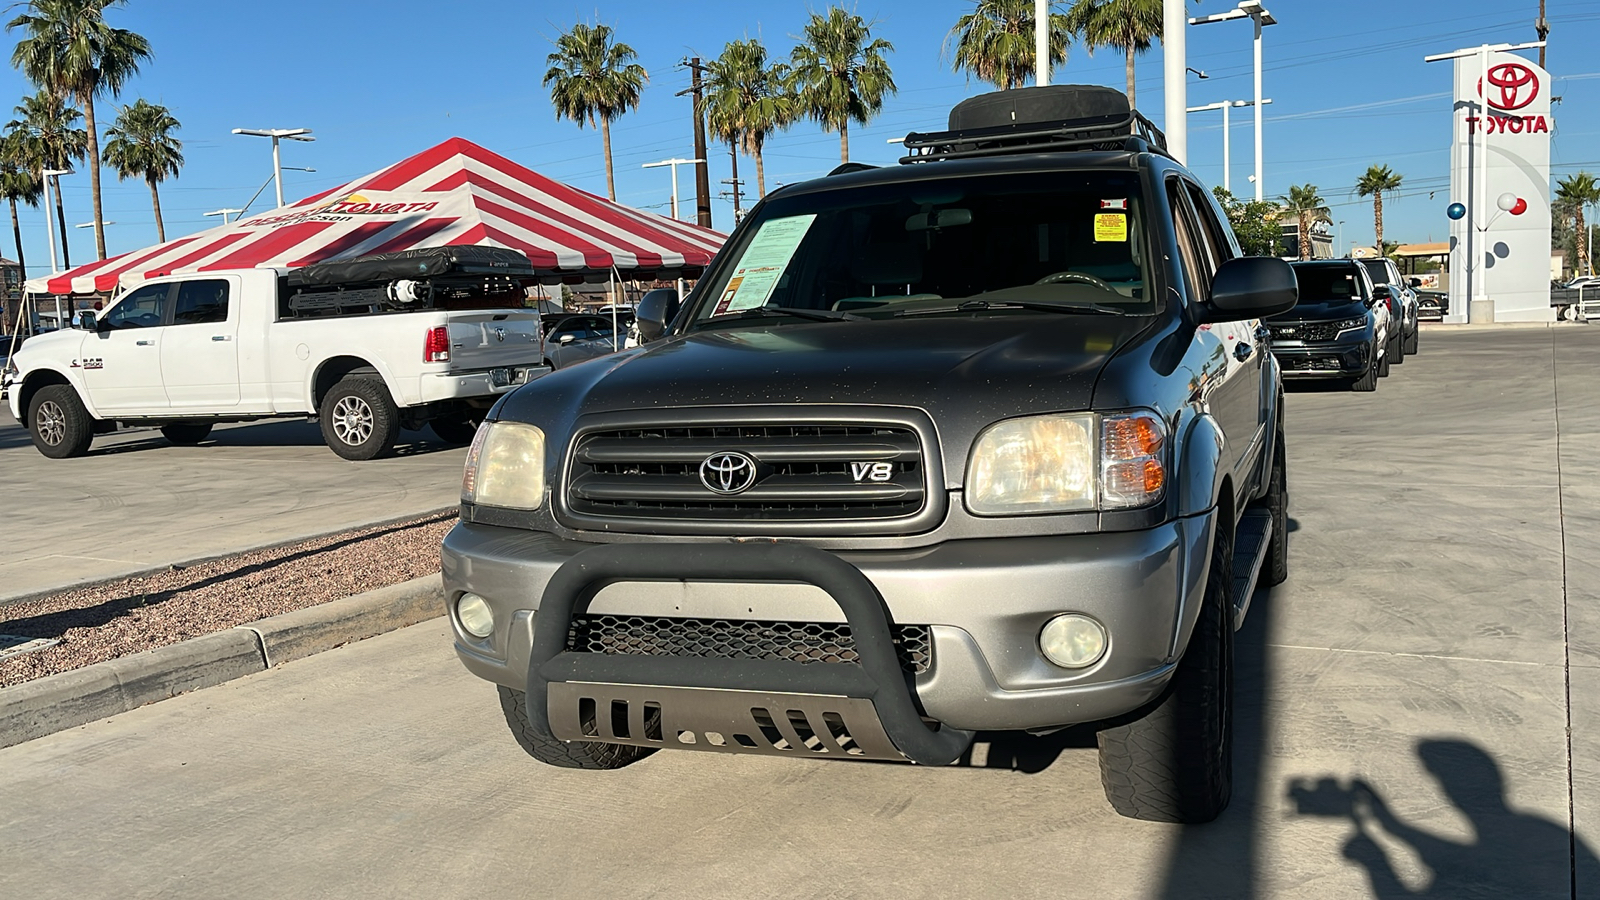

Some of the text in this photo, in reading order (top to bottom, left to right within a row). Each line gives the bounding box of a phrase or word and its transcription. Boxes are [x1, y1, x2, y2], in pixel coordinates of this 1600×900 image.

[1465, 115, 1548, 134] TOYOTA
[333, 201, 439, 214] TOYOTA
[850, 461, 893, 482] V8
